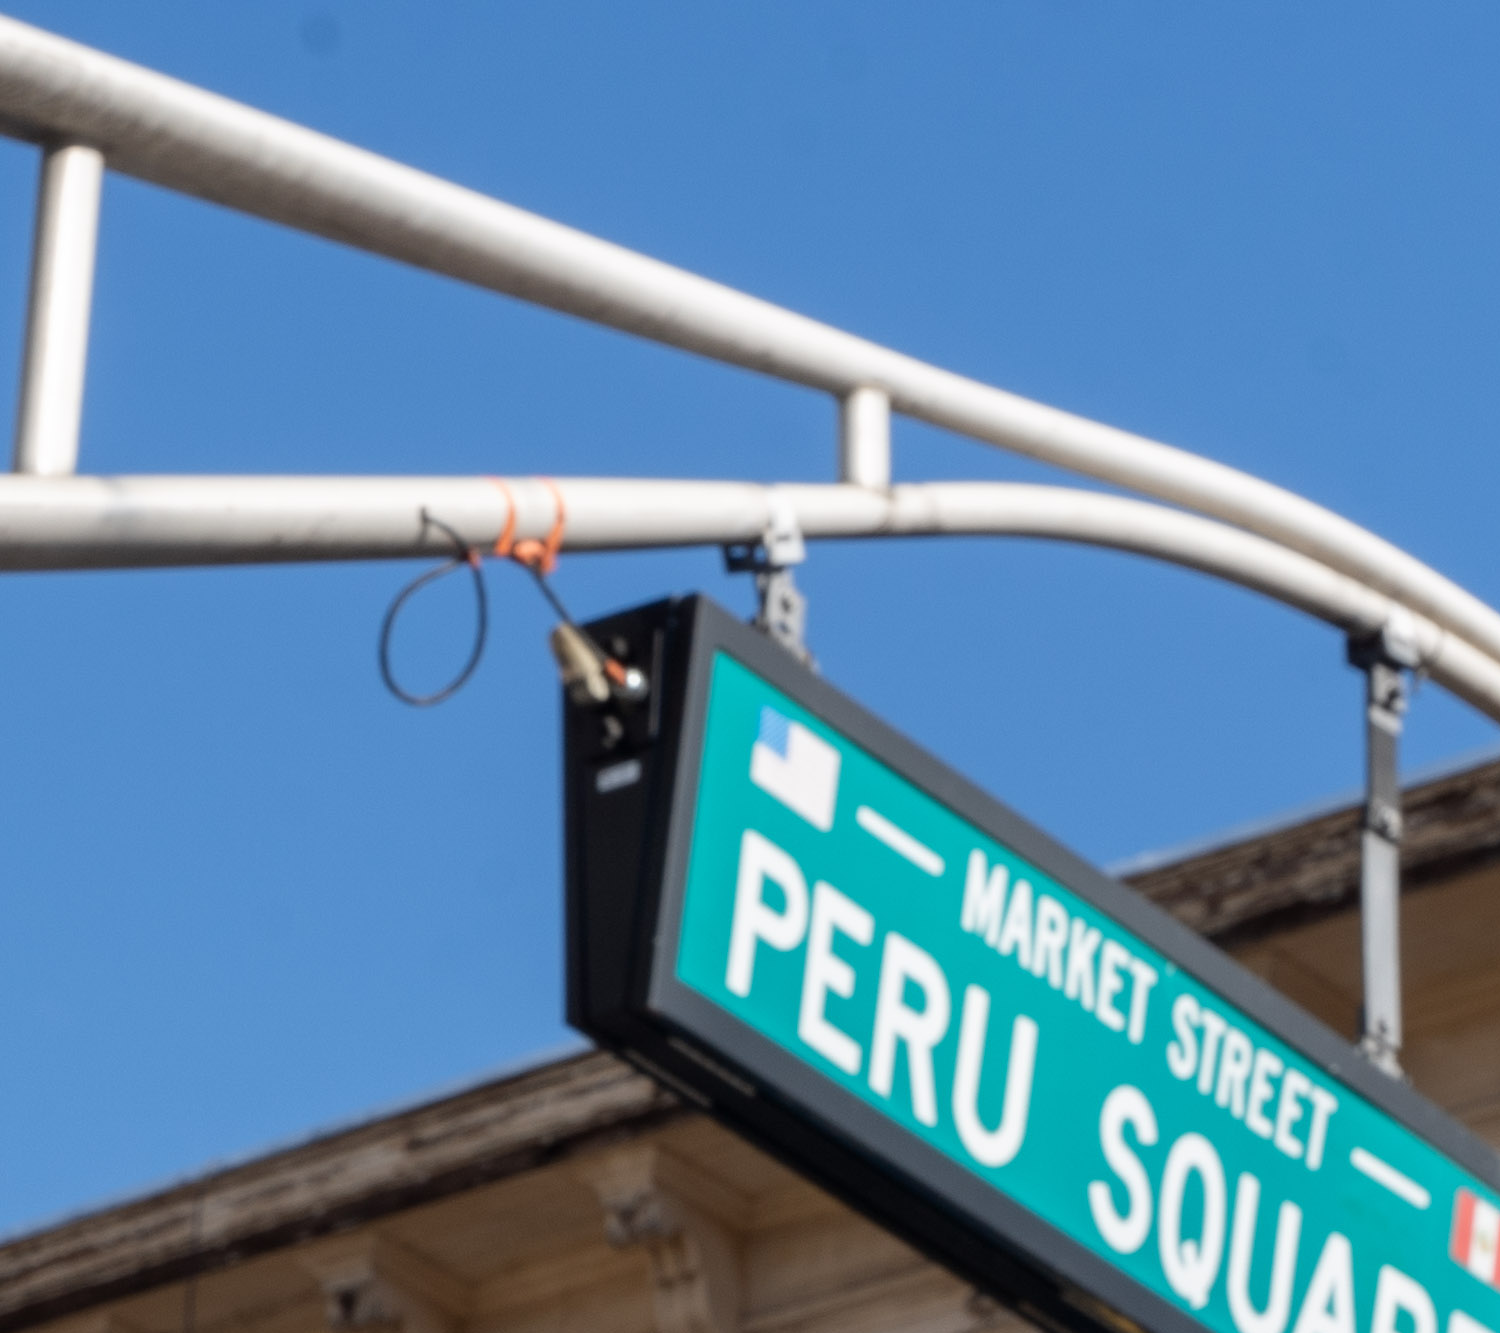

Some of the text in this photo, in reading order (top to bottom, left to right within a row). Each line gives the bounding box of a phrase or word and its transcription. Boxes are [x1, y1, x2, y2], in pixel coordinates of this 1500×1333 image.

[725, 829, 1040, 1170] PERU
[962, 848, 1338, 1171] MARKET STREET
